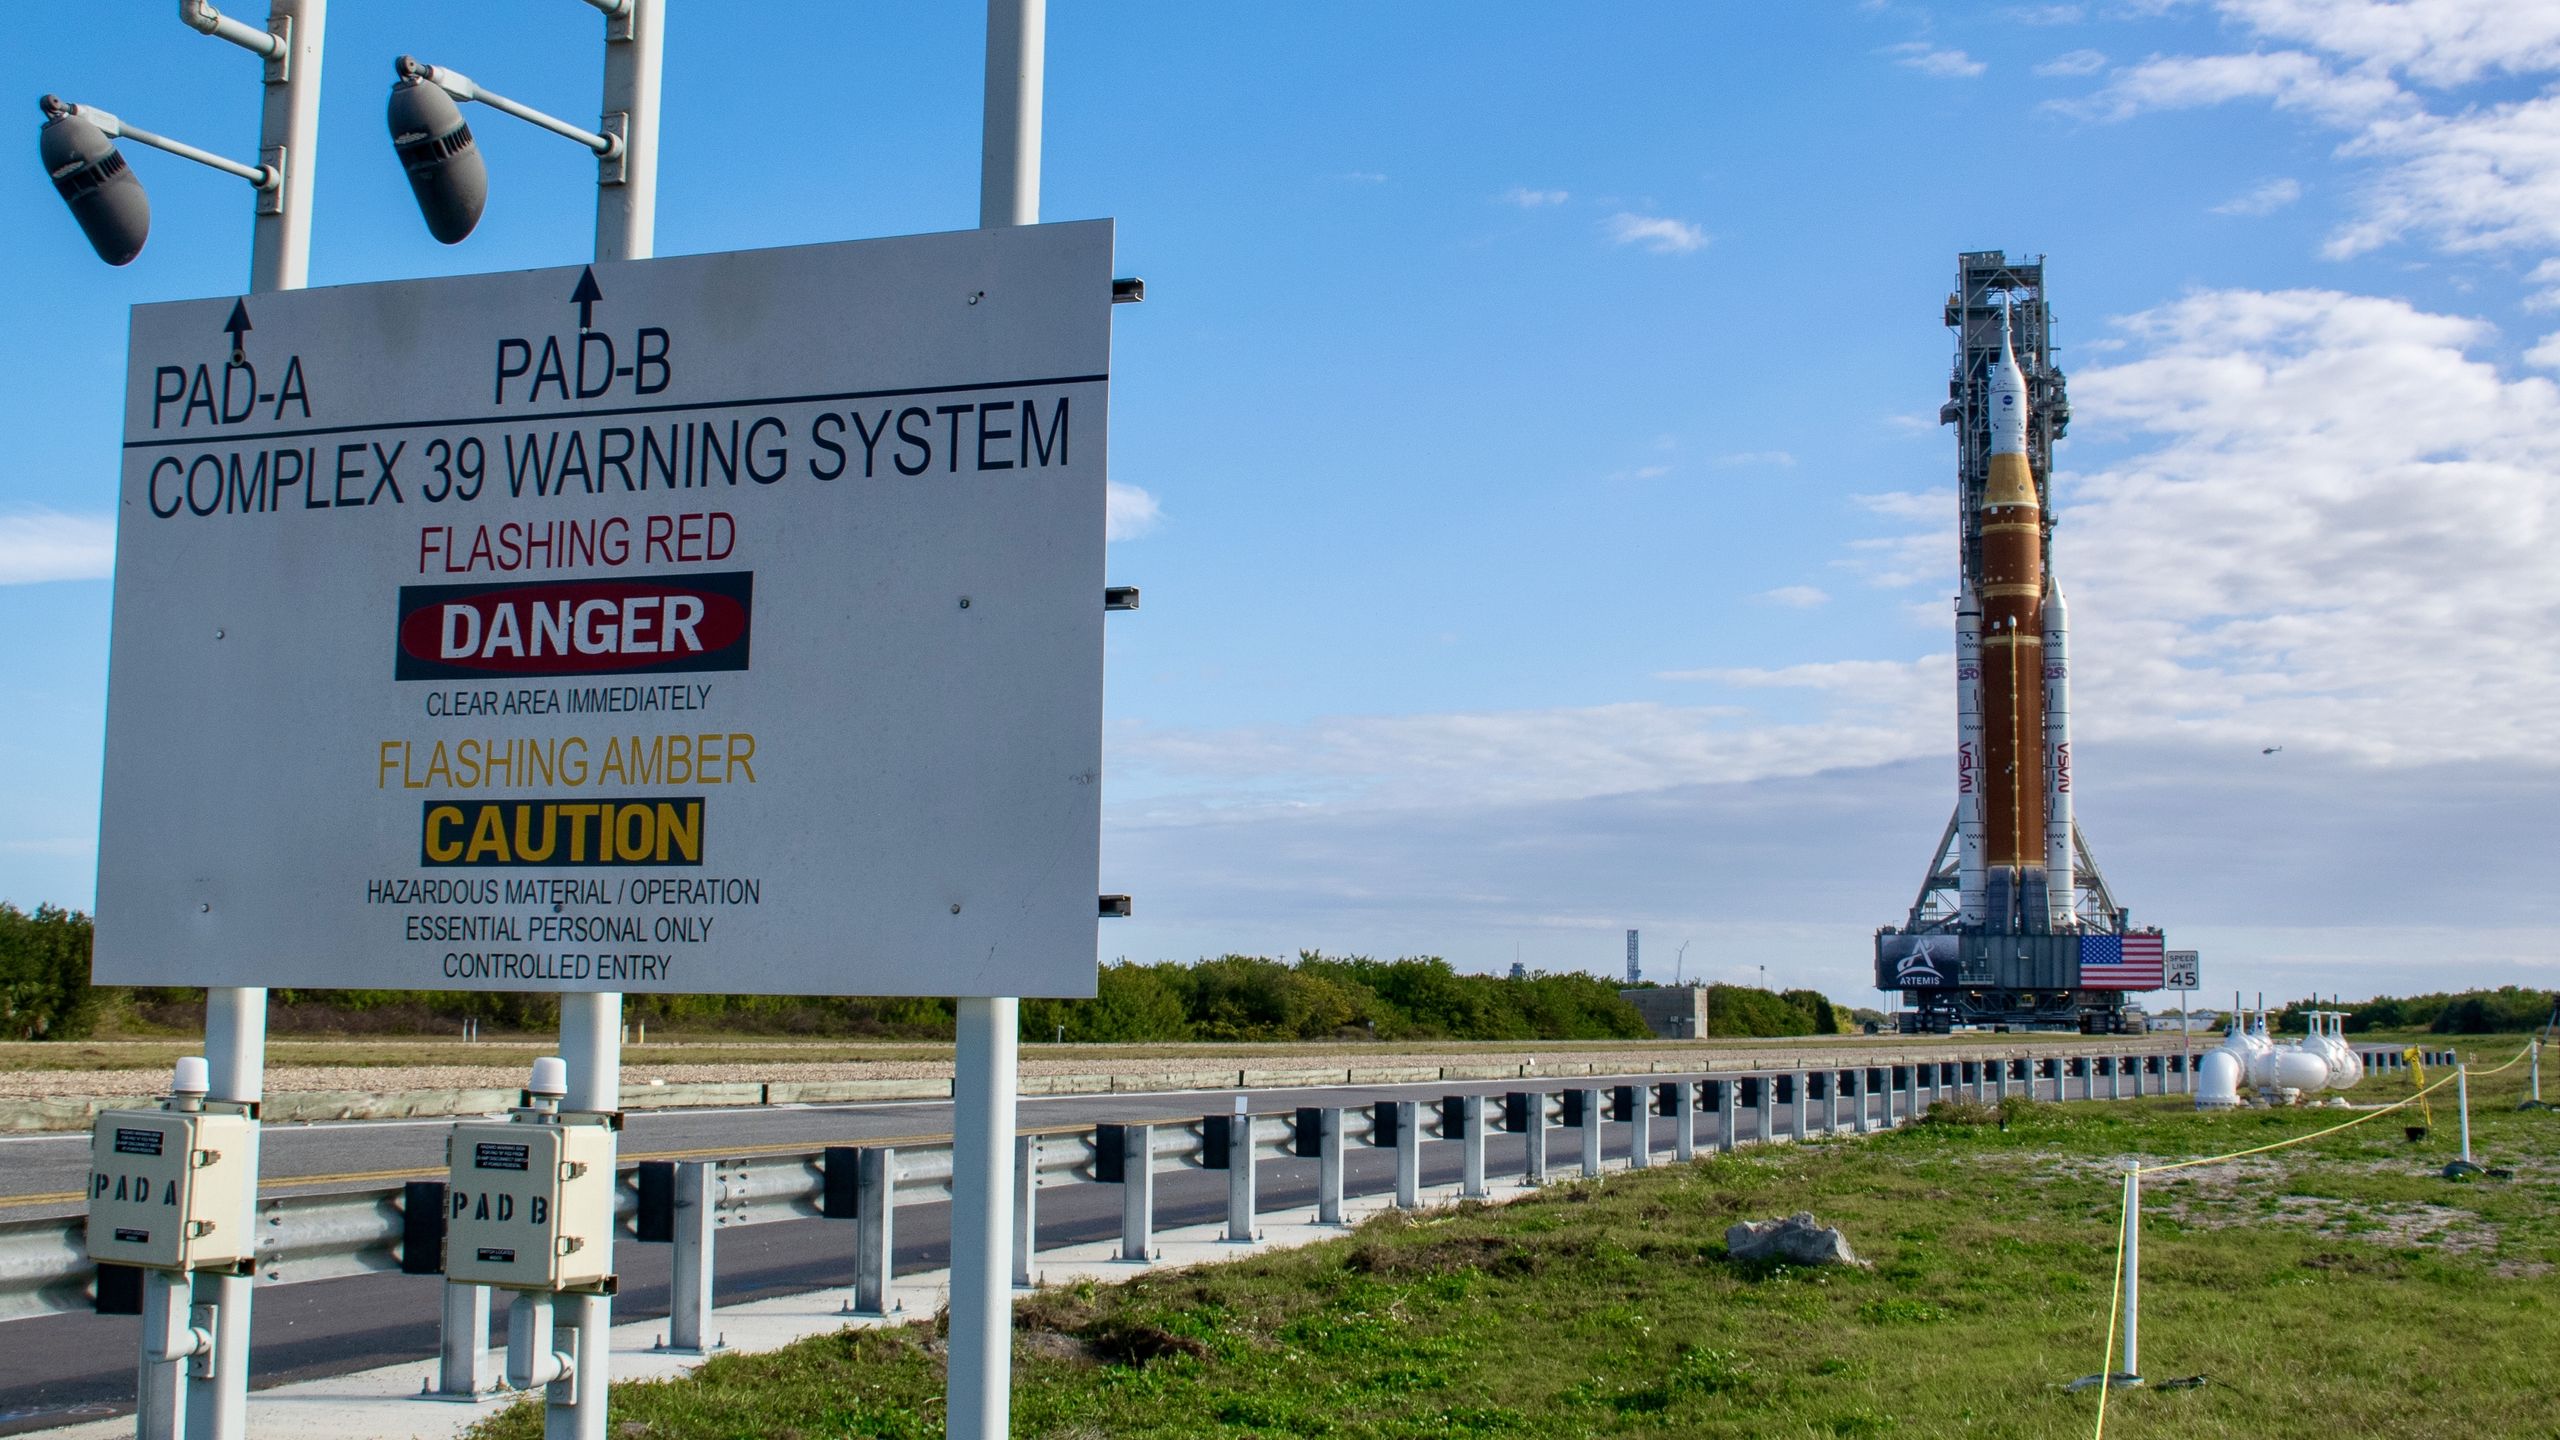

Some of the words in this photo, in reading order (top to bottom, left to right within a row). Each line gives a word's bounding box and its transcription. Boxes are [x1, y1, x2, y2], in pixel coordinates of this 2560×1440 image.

[495, 327, 671, 405] PAD-B
[153, 354, 312, 429] PAD-A
[149, 440, 406, 519] COMPLEX
[423, 437, 485, 502] 39
[504, 414, 788, 497] WARNING
[808, 396, 1069, 482] SYSTEM
[420, 517, 631, 574] FLASHING
[645, 511, 736, 564] RED
[441, 595, 705, 659] DANGER
[426, 691, 498, 717] CLEAR
[503, 690, 560, 715] AREA
[567, 684, 713, 713] IMMEDIATELY
[379, 737, 588, 789] FLASHING
[598, 733, 757, 785] AMBER
[1960, 741, 1972, 793] NASA
[2058, 743, 2070, 793] NASA
[425, 803, 701, 862] CAUTION
[368, 879, 498, 905] HAZARDOUS
[506, 879, 612, 905] MATERIAL
[618, 879, 626, 905] /
[631, 879, 760, 905] OPERATION
[406, 916, 521, 942] ESSENTIAL
[529, 917, 648, 942] PERSONAL
[655, 917, 714, 943] ONLY
[444, 953, 590, 980] CONTROLLED
[598, 955, 672, 981] ENTRY
[1900, 976, 1941, 985] ARTEMIS
[2169, 971, 2197, 986] 45
[95, 1173, 150, 1203] PAD
[163, 1180, 177, 1206] A
[453, 1191, 513, 1221] PAD
[531, 1196, 548, 1225] B
